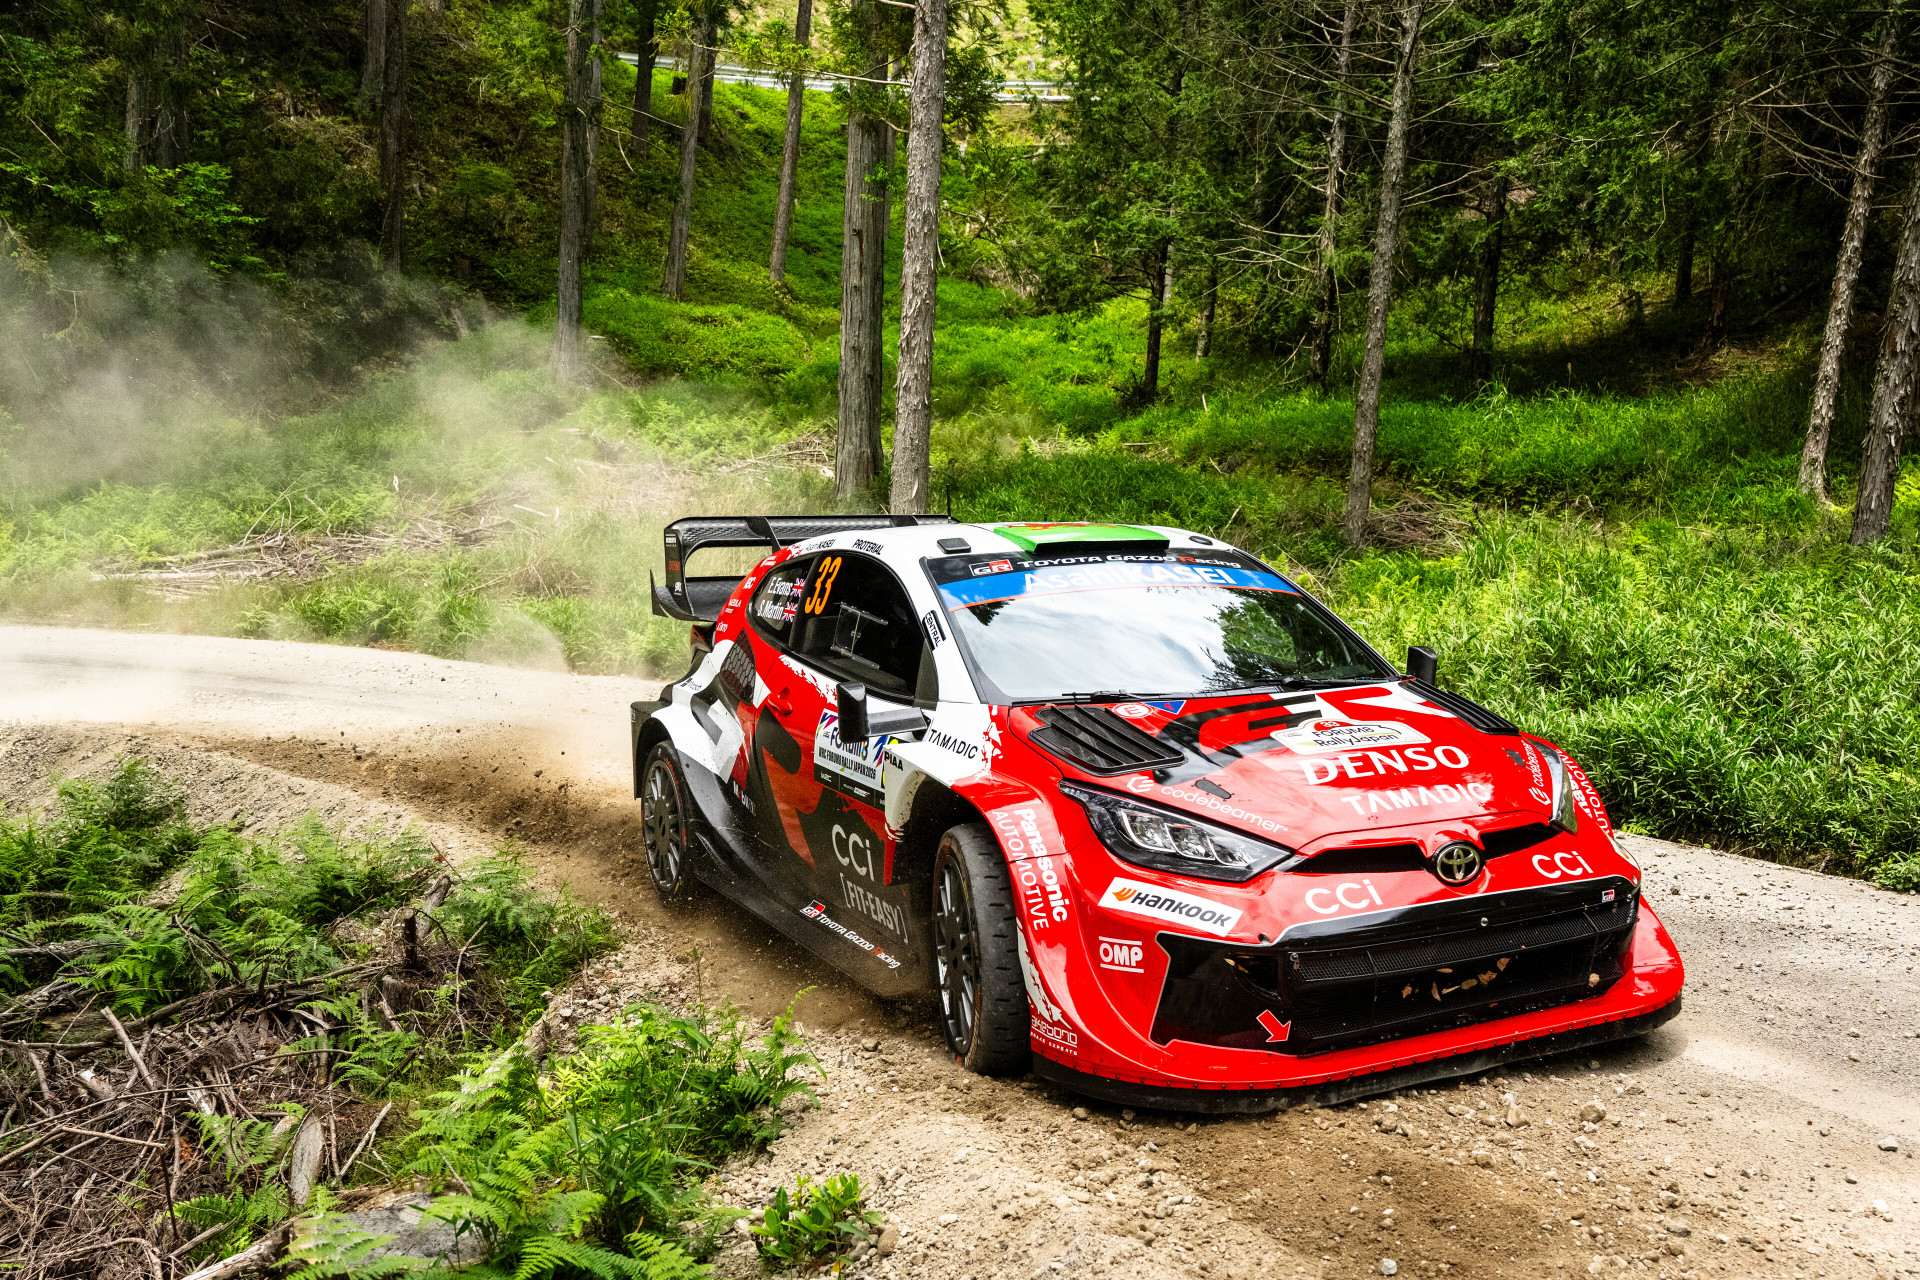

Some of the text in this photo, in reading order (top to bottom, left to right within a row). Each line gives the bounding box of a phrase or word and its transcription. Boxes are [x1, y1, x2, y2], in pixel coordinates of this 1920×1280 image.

[852, 539, 884, 555] PROTERIAL
[973, 562, 1012, 575] GR
[1017, 556, 1102, 568] TOYOTA
[1180, 556, 1241, 569] Racing
[1024, 564, 1237, 592] AsahiKASEI
[768, 577, 793, 597] E.Evans
[804, 556, 842, 615] 33
[925, 612, 941, 648] CENTRAL
[928, 728, 978, 760] TAMADIC
[1312, 727, 1375, 738] FORUM8
[841, 755, 854, 771] RALLY
[884, 750, 904, 772] PIAA
[1300, 746, 1469, 785] DENSO
[1160, 785, 1285, 832] codebeamer
[1341, 783, 1493, 817] TAMADIC
[991, 811, 1049, 931] AUTOMOTIVE
[1013, 808, 1070, 922] Panasonic
[802, 906, 820, 918] GR
[816, 913, 847, 935] TOYOTA
[871, 946, 901, 969] Racing
[1099, 943, 1143, 967] OMP
[1031, 1015, 1078, 1045] akebono
